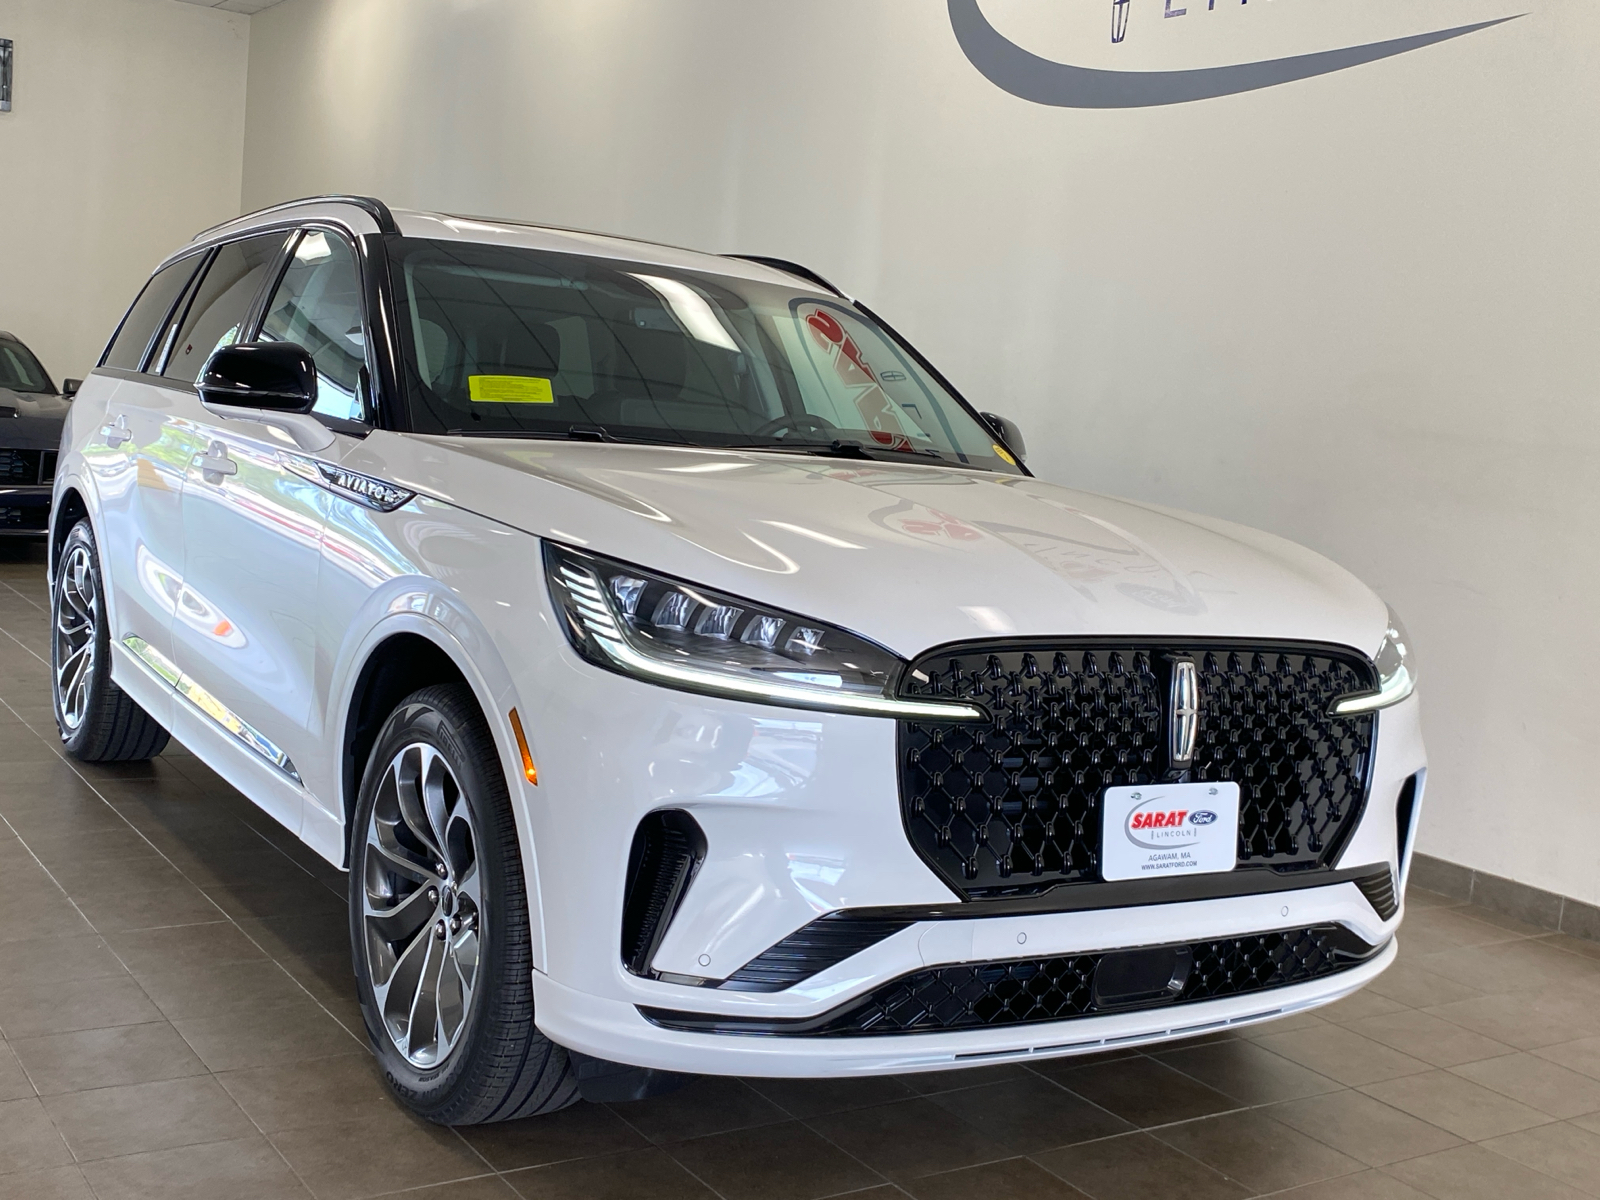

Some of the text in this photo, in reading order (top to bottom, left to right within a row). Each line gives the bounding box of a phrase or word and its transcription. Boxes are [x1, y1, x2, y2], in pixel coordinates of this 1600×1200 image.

[338, 472, 395, 502] AVIATOR
[1131, 810, 1214, 830] SARAT Ford
[1156, 830, 1191, 838] LINCOLN
[1148, 853, 1179, 862] AGAWAM,
[1141, 861, 1197, 871] WWW.SARATFORD.COM
